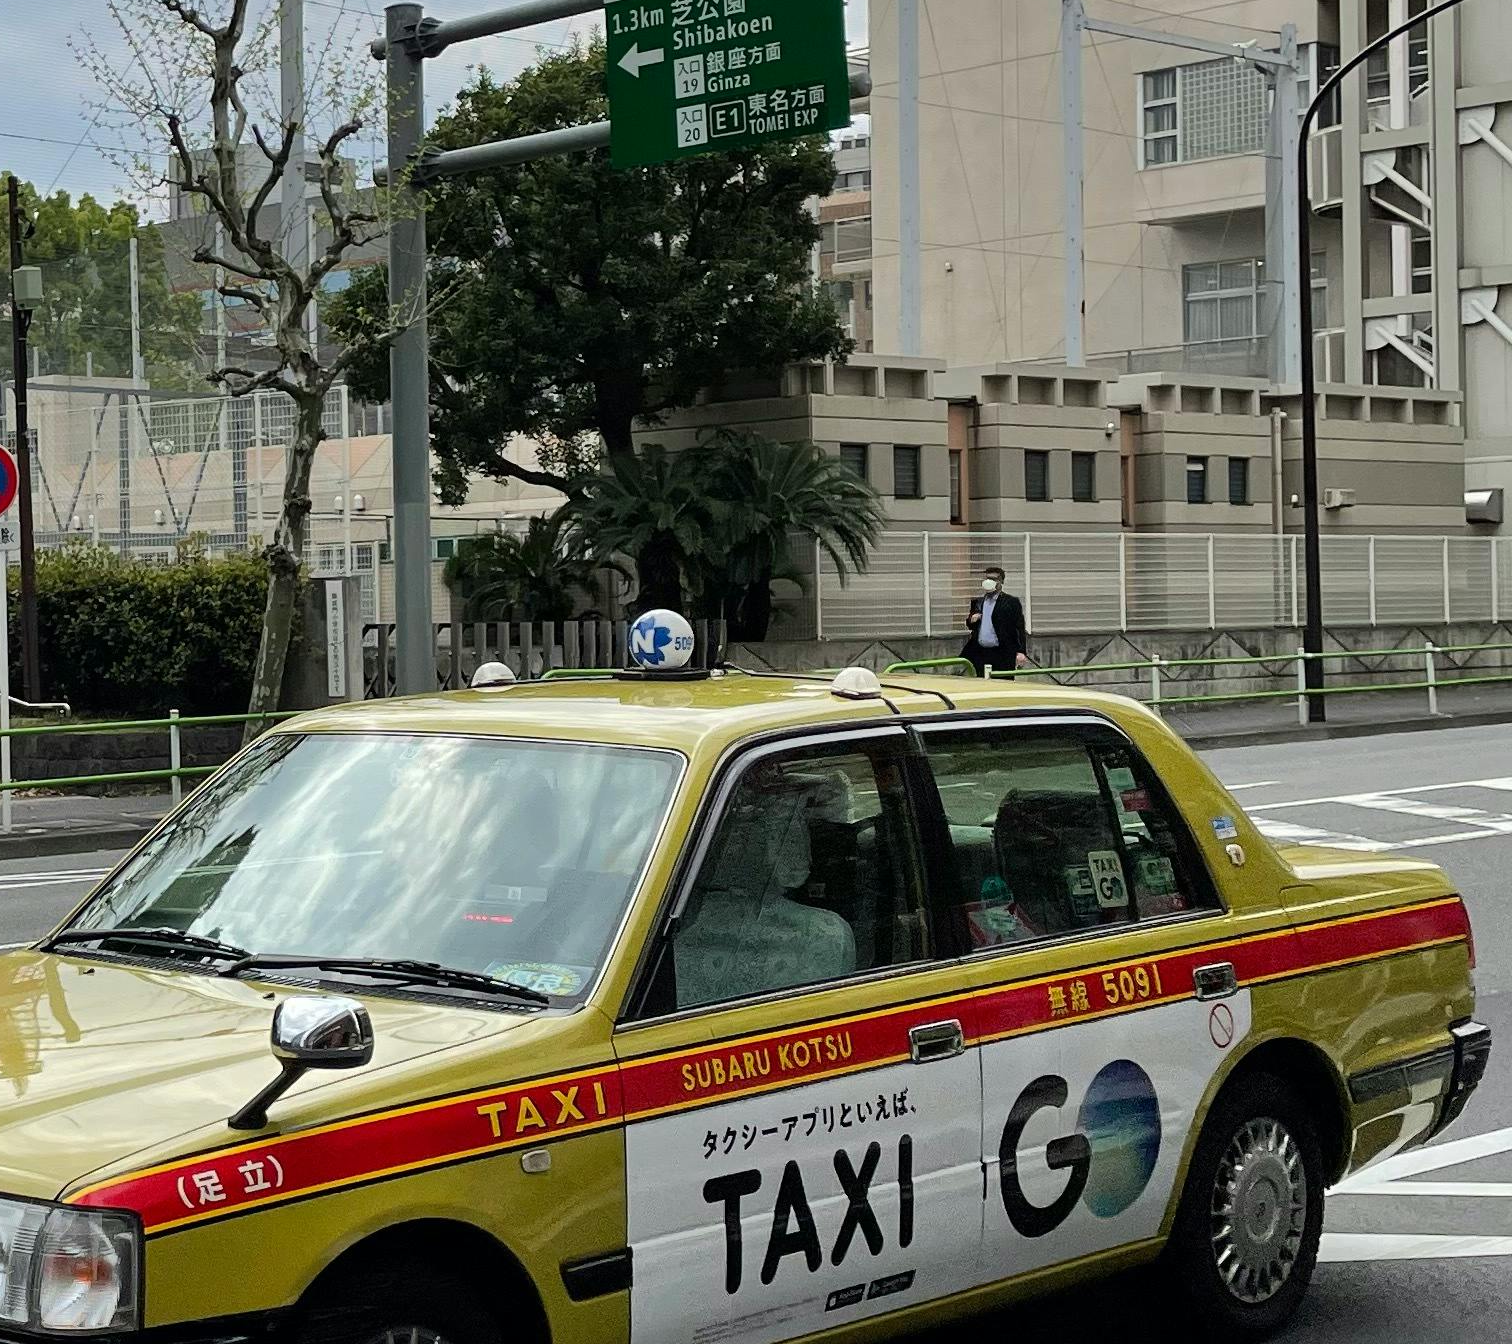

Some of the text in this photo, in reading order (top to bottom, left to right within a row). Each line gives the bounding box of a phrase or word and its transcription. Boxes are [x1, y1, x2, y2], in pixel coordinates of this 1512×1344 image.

[613, 6, 664, 34] 1.3km
[673, 15, 773, 51] Shibakoen
[678, 62, 700, 75] 入口
[706, 42, 781, 74] 銀座方面
[683, 79, 699, 94] 19
[707, 73, 751, 93] Ginza
[681, 111, 703, 124] 入口
[716, 85, 825, 130] E1 東名方面
[749, 109, 819, 135] TOMEI EXP
[685, 128, 700, 143] 20
[1092, 856, 1122, 873] TAXI
[1046, 962, 1163, 1016] 無線 5091
[681, 1031, 853, 1092] SUBARU KOTSU
[477, 1081, 608, 1138] TAXI
[703, 1086, 917, 1159] タクシーアプリといえば、
[703, 1058, 1163, 1295] TAXI GO
